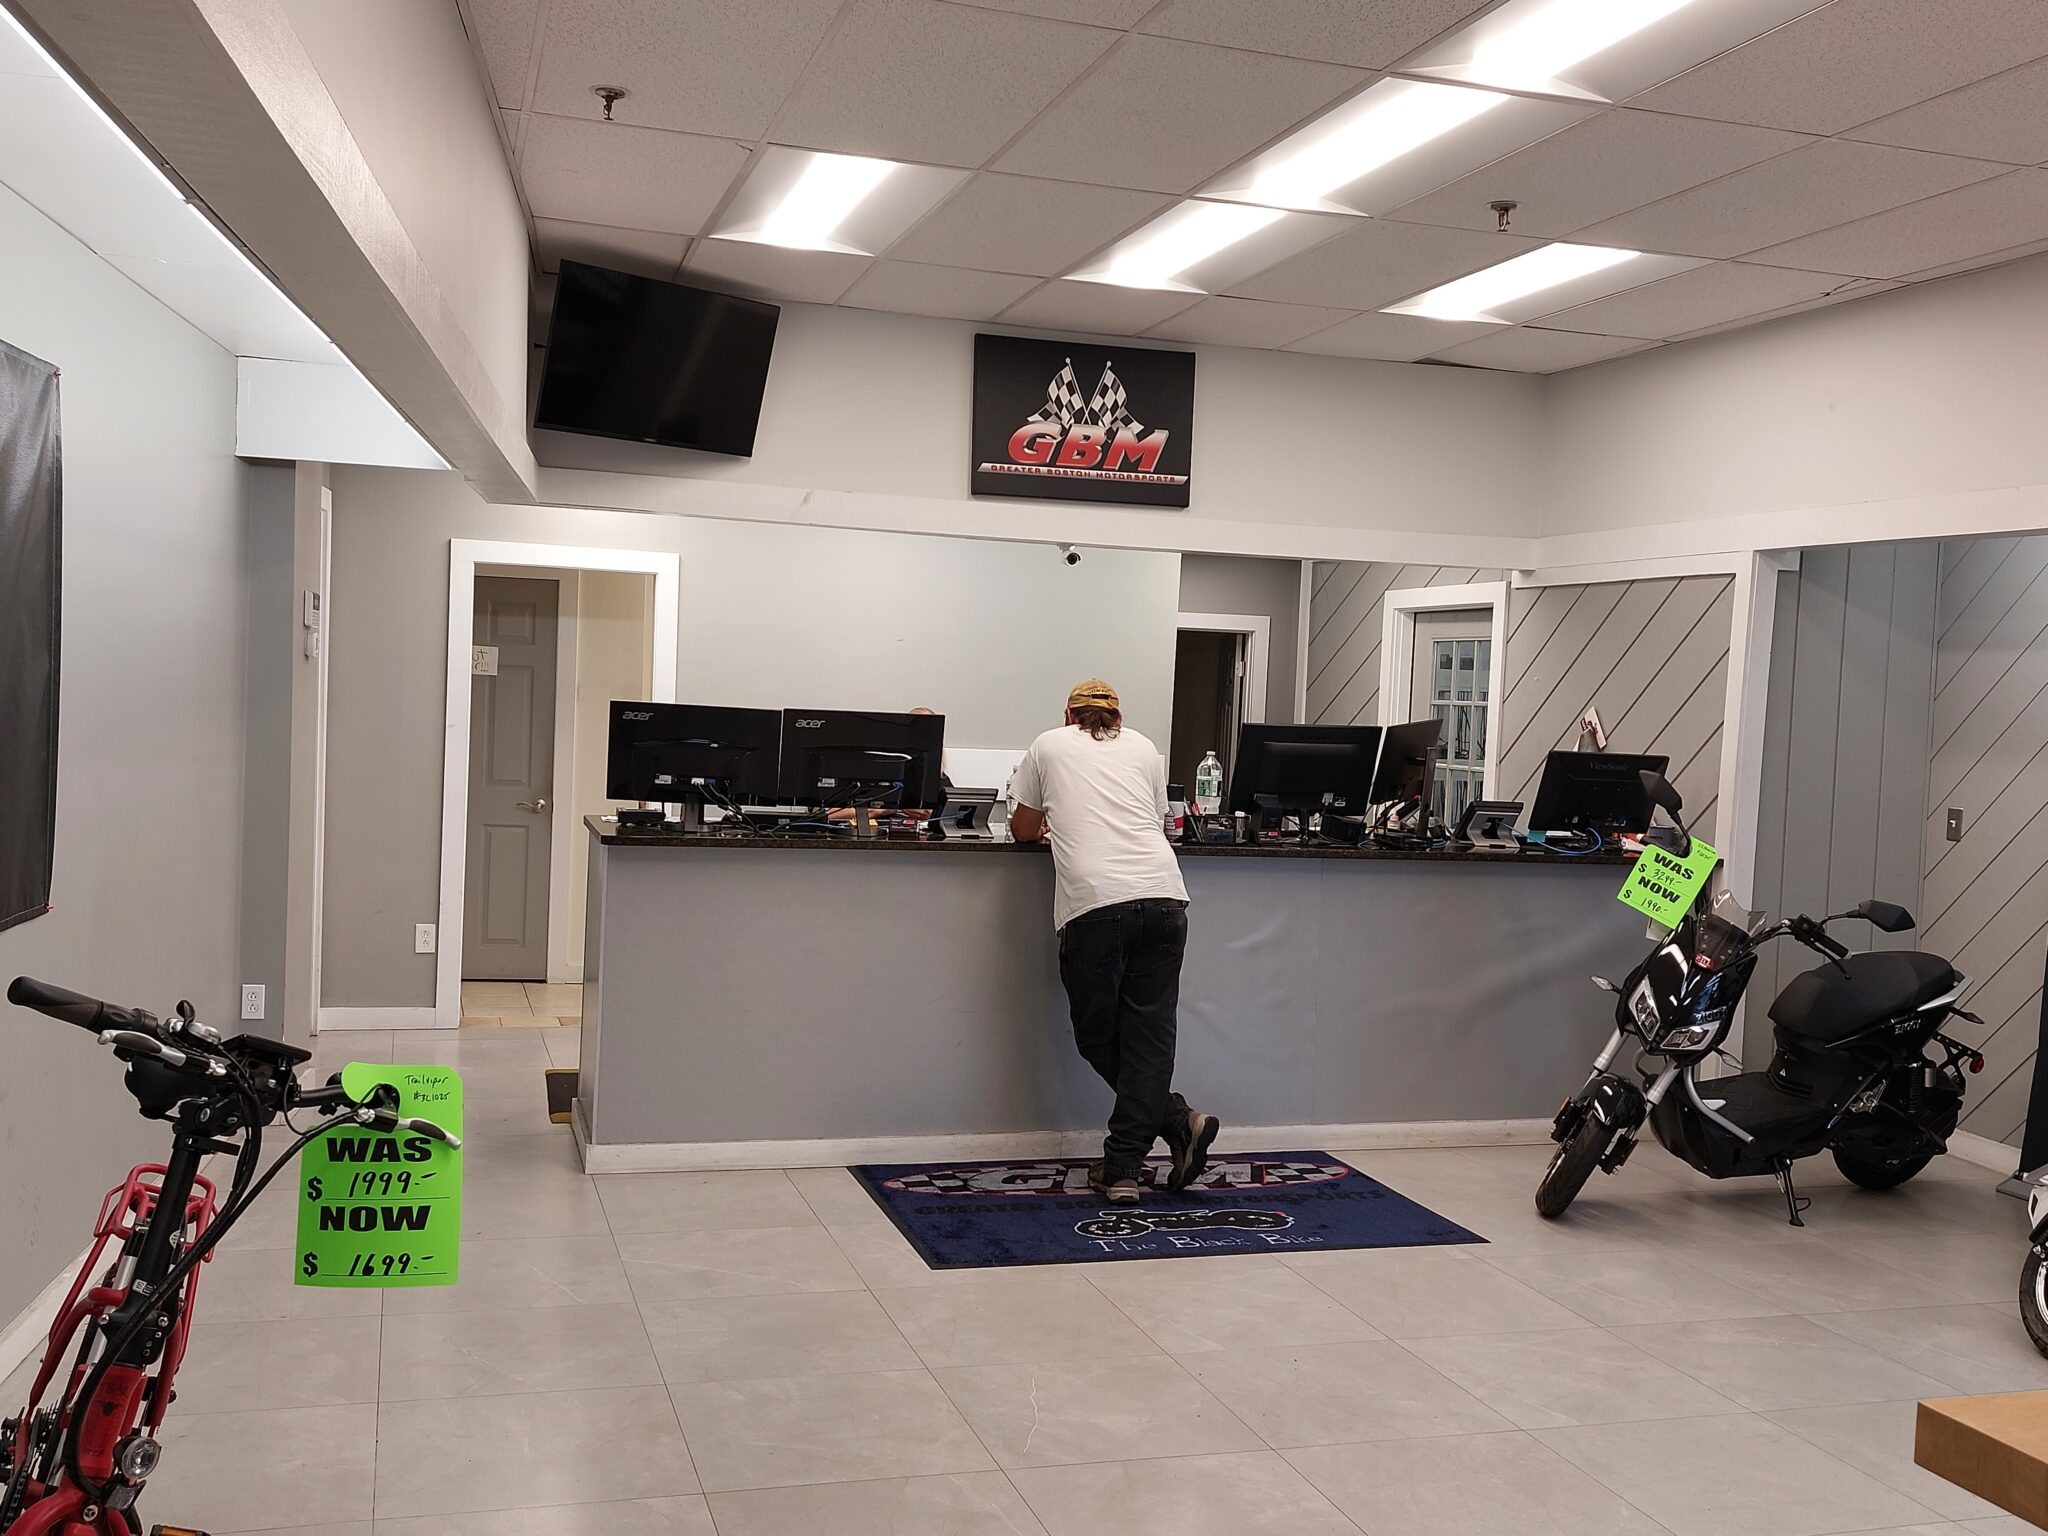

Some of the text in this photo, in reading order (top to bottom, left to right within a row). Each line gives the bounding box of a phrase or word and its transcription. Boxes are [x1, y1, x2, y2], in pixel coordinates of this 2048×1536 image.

[1007, 421, 1170, 472] GBM
[991, 465, 1176, 483] GREATER BOSTON MOTORSPORTS
[622, 711, 653, 721] acer
[795, 718, 826, 729] acer
[1638, 863, 1648, 873] $
[1653, 852, 1694, 880] WAS
[1623, 889, 1632, 899] $
[1637, 876, 1681, 903] NOW
[326, 1137, 432, 1163] WAS
[307, 1176, 323, 1201] $
[319, 1205, 431, 1231] NOW
[1089, 1239, 1157, 1252] The
[1257, 1233, 1324, 1245] Bike
[303, 1252, 318, 1278] $
